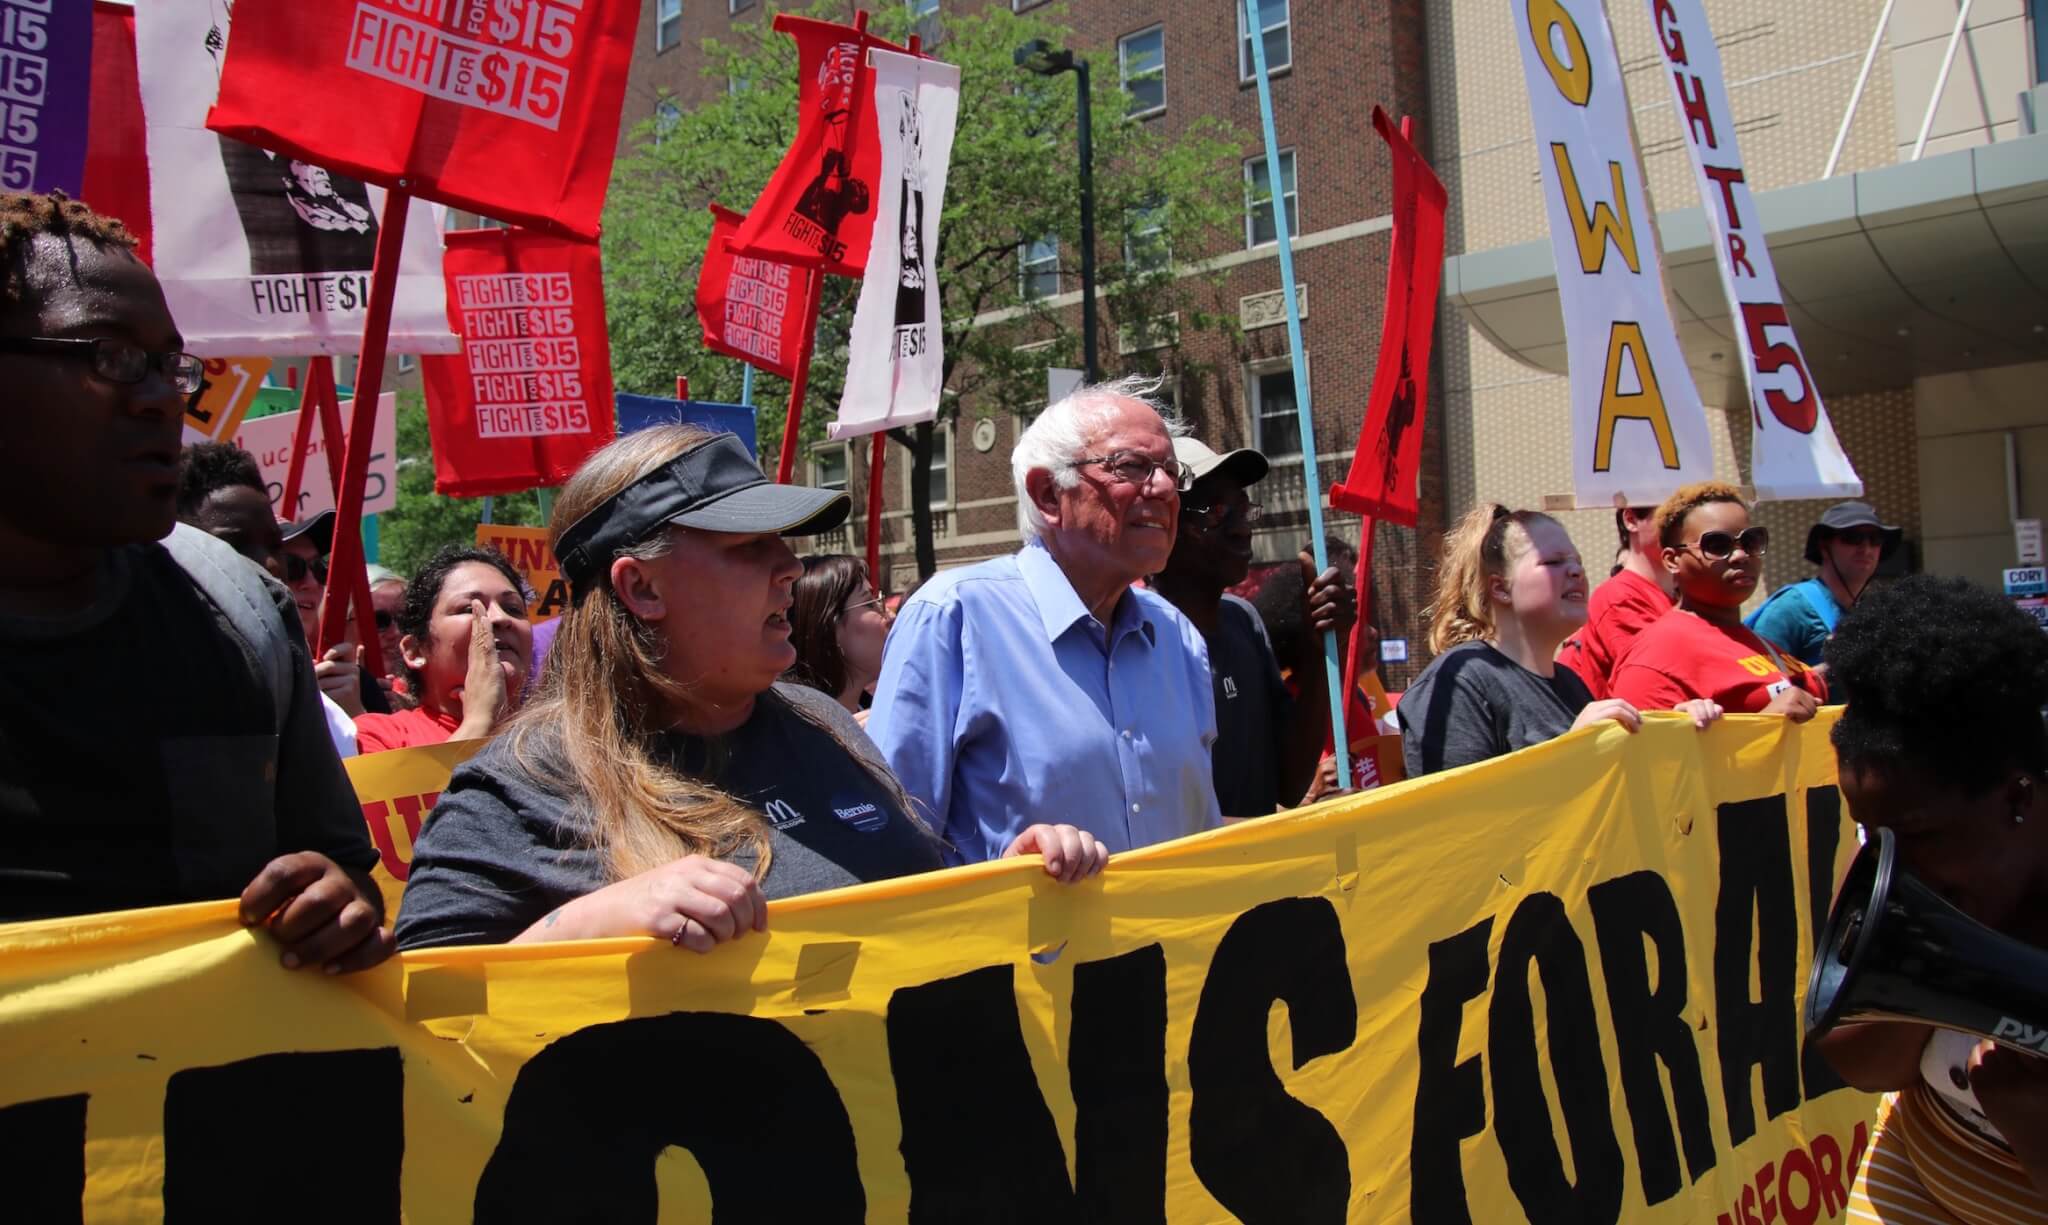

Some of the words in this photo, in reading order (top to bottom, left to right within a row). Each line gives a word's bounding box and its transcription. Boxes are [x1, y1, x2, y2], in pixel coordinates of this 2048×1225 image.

[351, 10, 482, 91] FIGHT
[454, 56, 476, 96] FOR
[476, 51, 563, 119] $15
[782, 212, 825, 246] FIGHT
[818, 233, 848, 263] $15
[251, 276, 336, 314] FIGHT
[325, 283, 336, 311] FOR
[339, 274, 368, 311] $1
[458, 277, 523, 305] FIGHT
[515, 281, 524, 302] FOR
[525, 275, 569, 302] $15
[464, 308, 528, 338] FIGHT
[520, 313, 528, 335] FOR
[529, 306, 574, 336] $15
[469, 342, 532, 370] FIGHT
[524, 346, 532, 368] FOR
[533, 340, 578, 367] $15
[473, 374, 537, 402] FIGHT
[529, 378, 537, 399] FOR
[538, 371, 583, 400] $15
[479, 406, 543, 434] FIGHT
[534, 410, 543, 431] FOR
[544, 404, 587, 432] $15
[834, 802, 877, 820] Bernie
[1410, 869, 1717, 1225] FOR
